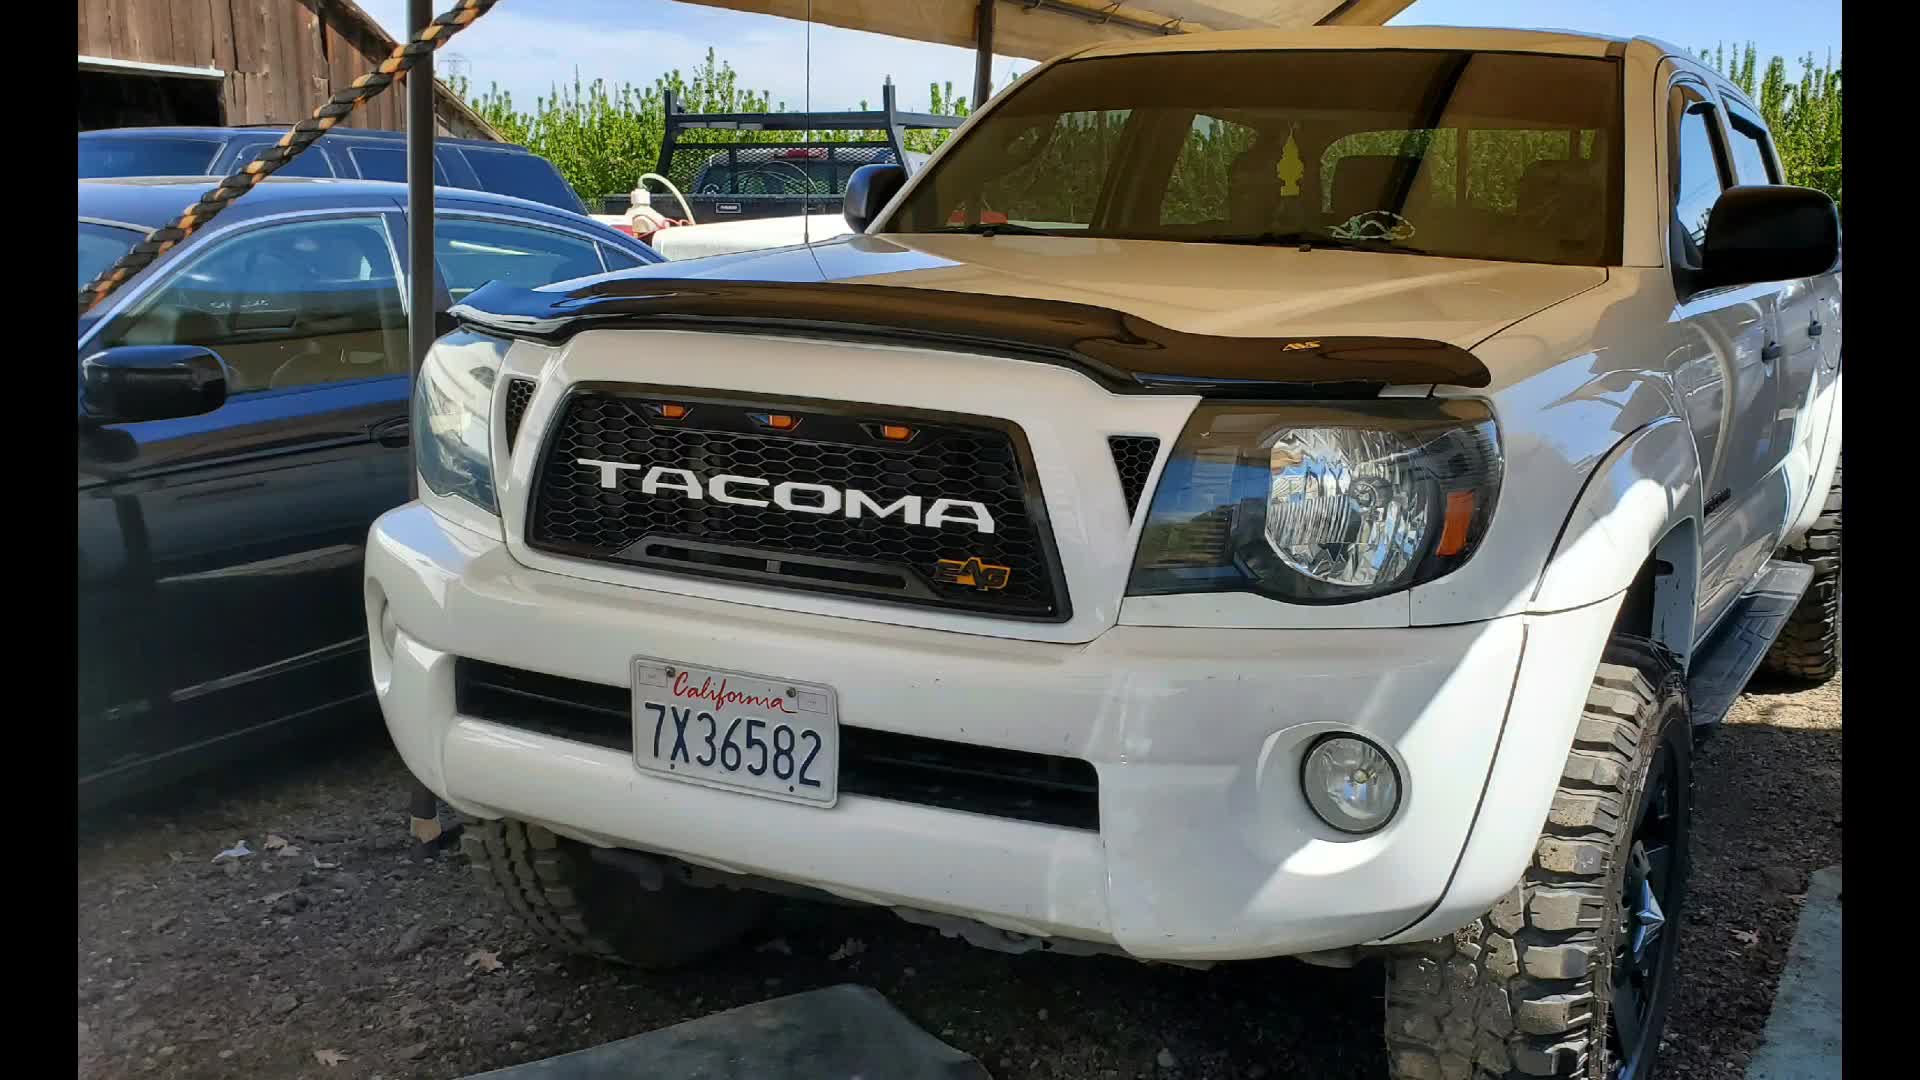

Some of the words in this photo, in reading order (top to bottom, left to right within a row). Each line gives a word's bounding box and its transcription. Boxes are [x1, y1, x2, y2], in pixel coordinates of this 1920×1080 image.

[577, 458, 995, 533] TACOMA
[673, 671, 798, 712] California
[645, 701, 822, 788] 7X36582
